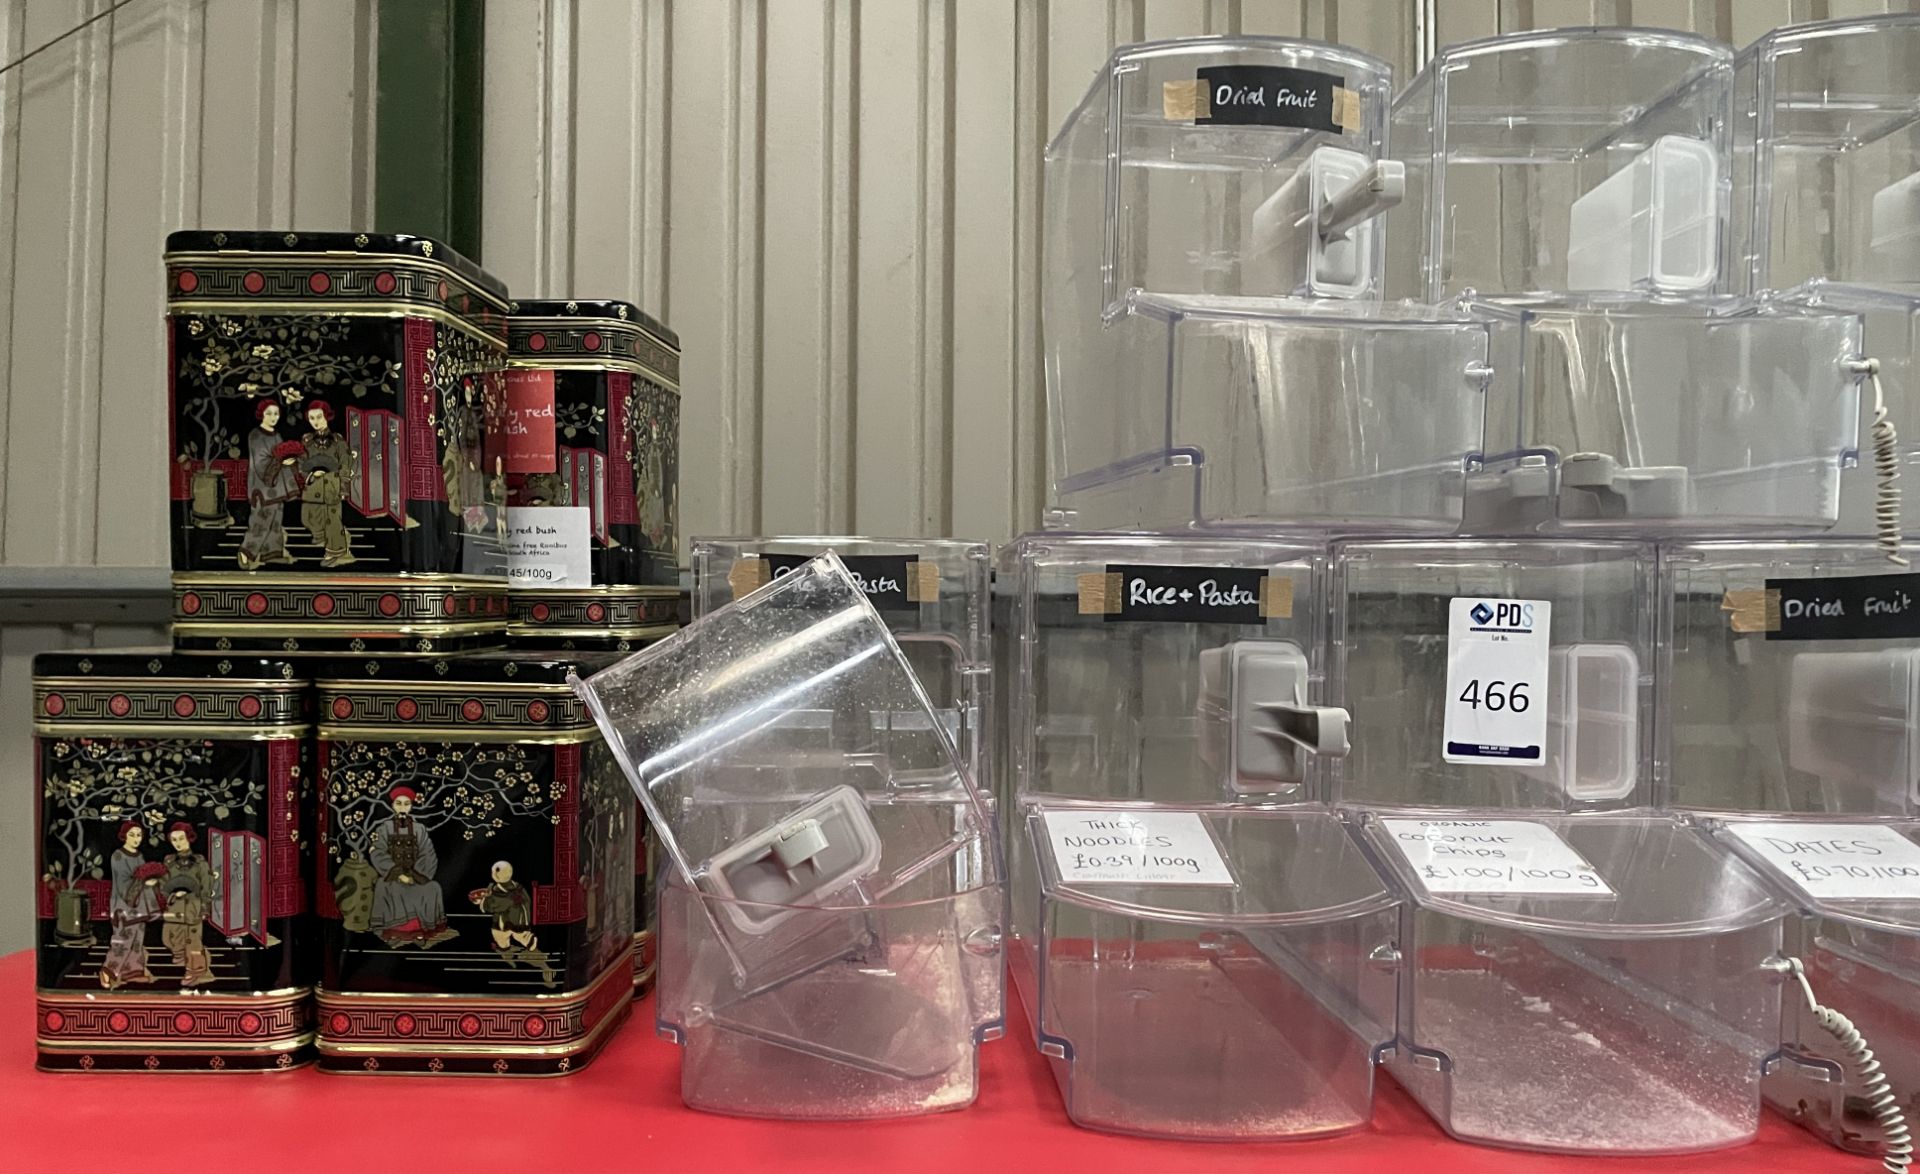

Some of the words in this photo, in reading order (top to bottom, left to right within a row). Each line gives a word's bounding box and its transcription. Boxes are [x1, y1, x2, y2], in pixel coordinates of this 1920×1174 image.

[1216, 85, 1265, 107] Dried
[1277, 88, 1318, 108] Fruit
[525, 403, 554, 418] red
[515, 526, 532, 535] red
[536, 525, 557, 535] bush
[509, 568, 552, 580] 45/100g
[1199, 579, 1260, 606] Pasta
[1785, 598, 1845, 618] Dried
[1864, 590, 1911, 616] Fruit
[1497, 603, 1533, 628] PDS
[1459, 679, 1529, 712] 466
[1080, 820, 1142, 830] THICK
[1064, 836, 1173, 848] NOODLES
[1764, 837, 1882, 855] DATES
